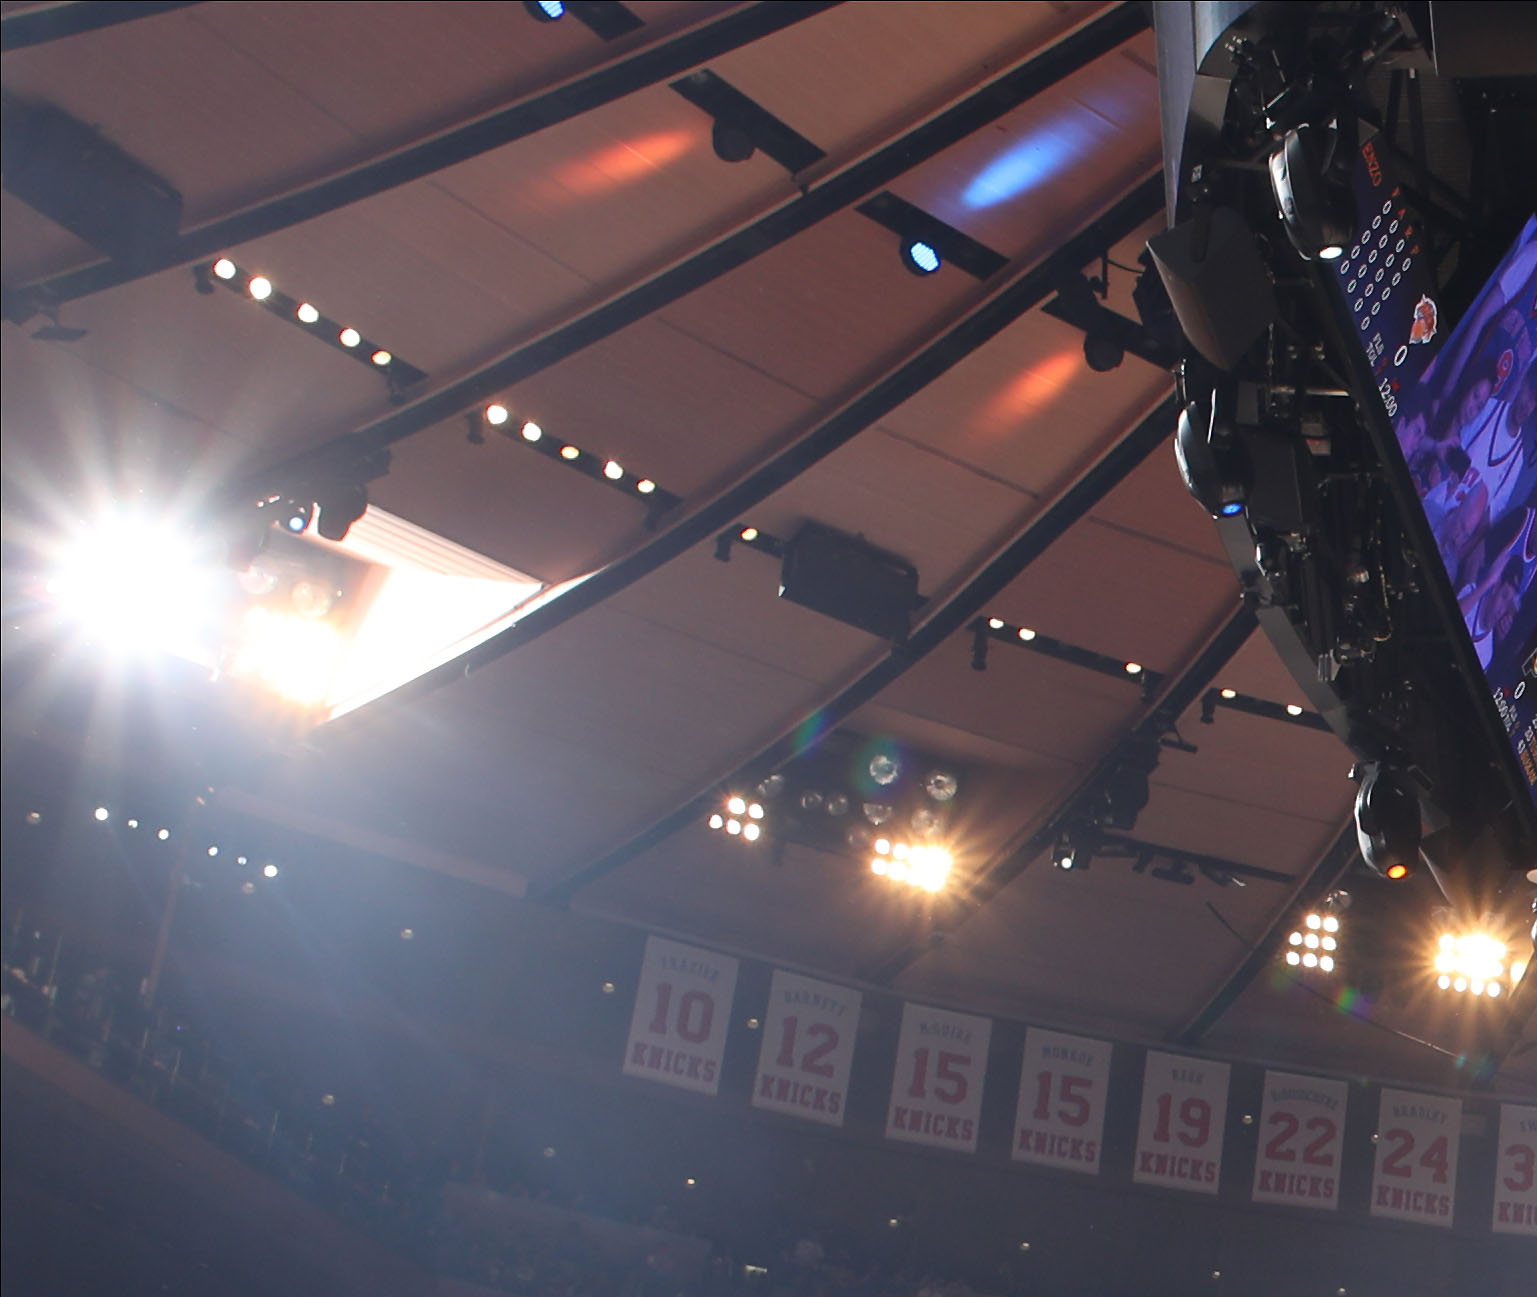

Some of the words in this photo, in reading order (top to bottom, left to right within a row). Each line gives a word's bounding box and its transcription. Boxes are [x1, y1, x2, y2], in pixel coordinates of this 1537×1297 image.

[1394, 345, 1408, 367] 0
[1514, 681, 1526, 700] 0
[650, 982, 715, 1044] 10
[631, 1042, 718, 1083] KNICKS
[775, 1015, 840, 1079] 12
[759, 1074, 842, 1115] KNICKS
[908, 1047, 972, 1105] 15
[1032, 1070, 1093, 1127] 15
[893, 1106, 975, 1142] KNICKS
[1152, 1092, 1212, 1148] 19
[1265, 1111, 1338, 1167] 22
[1017, 1128, 1097, 1163] KNICKS
[1381, 1128, 1449, 1185] 24
[1138, 1151, 1216, 1184] KNICKS
[1257, 1169, 1335, 1200] KNICKS
[1376, 1184, 1450, 1216] KNICKS
